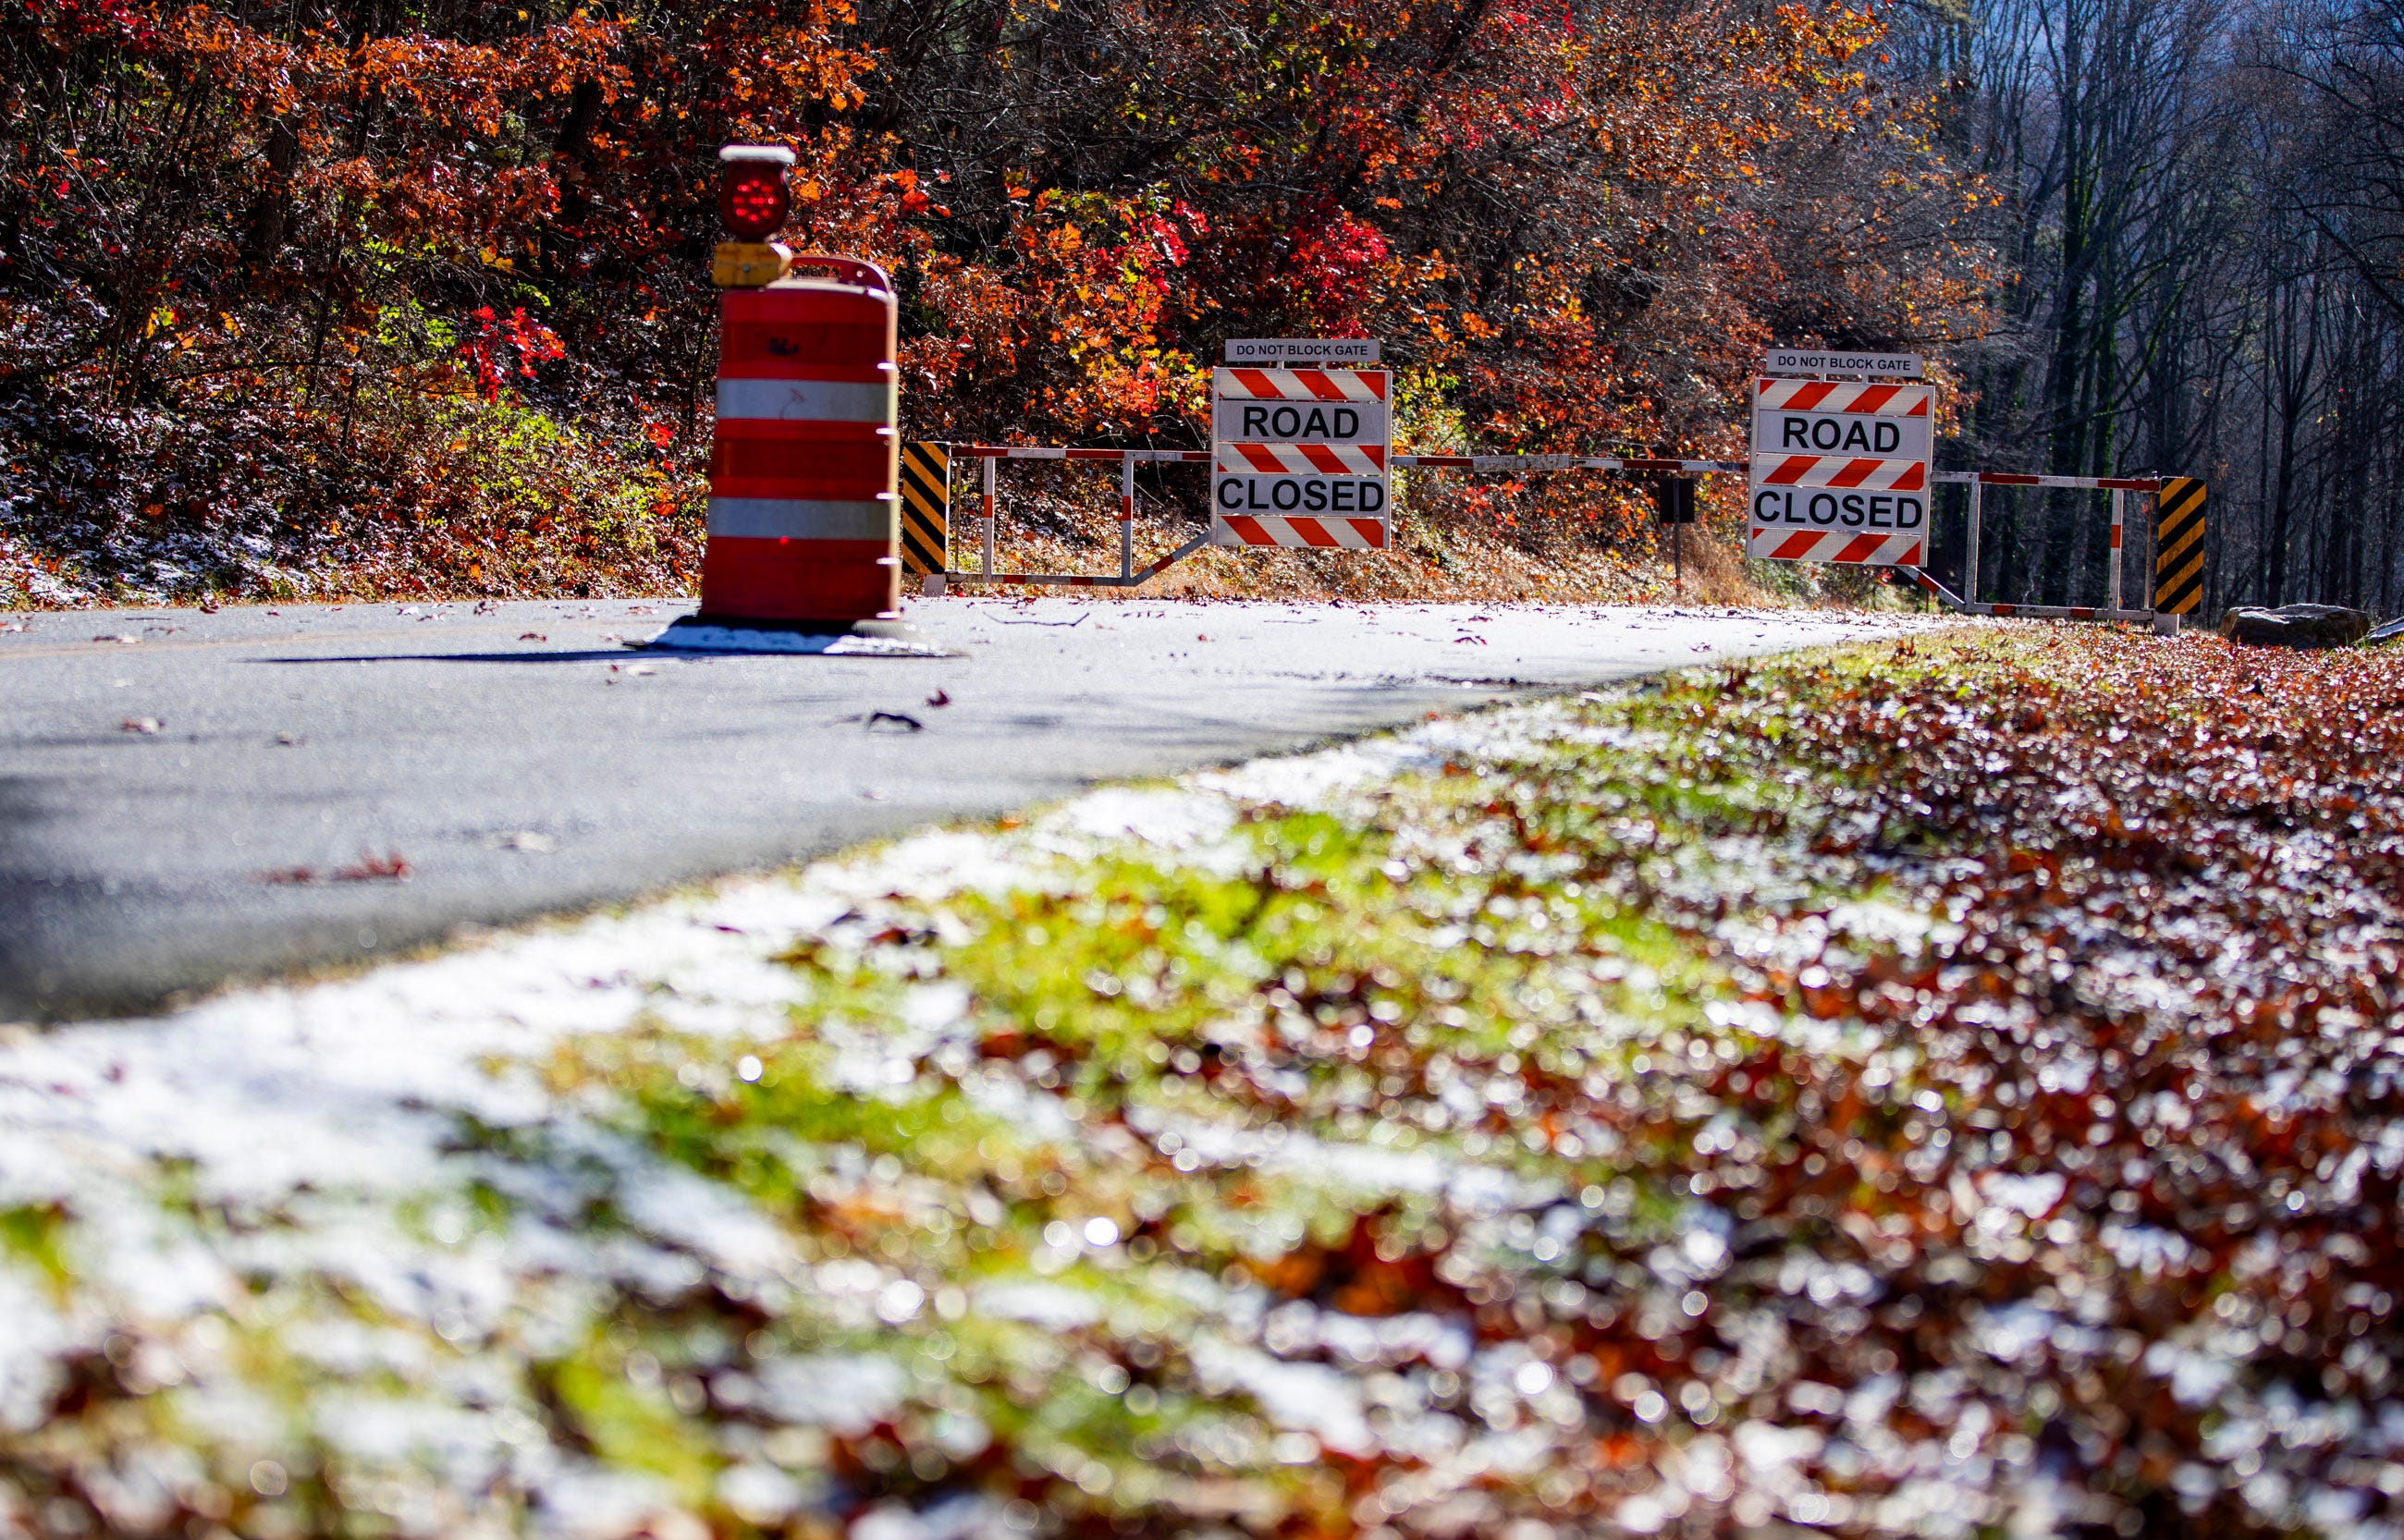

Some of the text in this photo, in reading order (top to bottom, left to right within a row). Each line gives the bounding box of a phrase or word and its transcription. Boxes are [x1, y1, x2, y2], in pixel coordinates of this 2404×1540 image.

[1236, 345, 1368, 356] DO NOT BLOCK GATE
[1777, 356, 1911, 371] DO NOT BLOCK GATE
[1243, 406, 1359, 438] ROAD
[1783, 417, 1900, 453] ROAD
[1218, 478, 1384, 511] CLOSED
[1754, 491, 1922, 529] CLOSED
